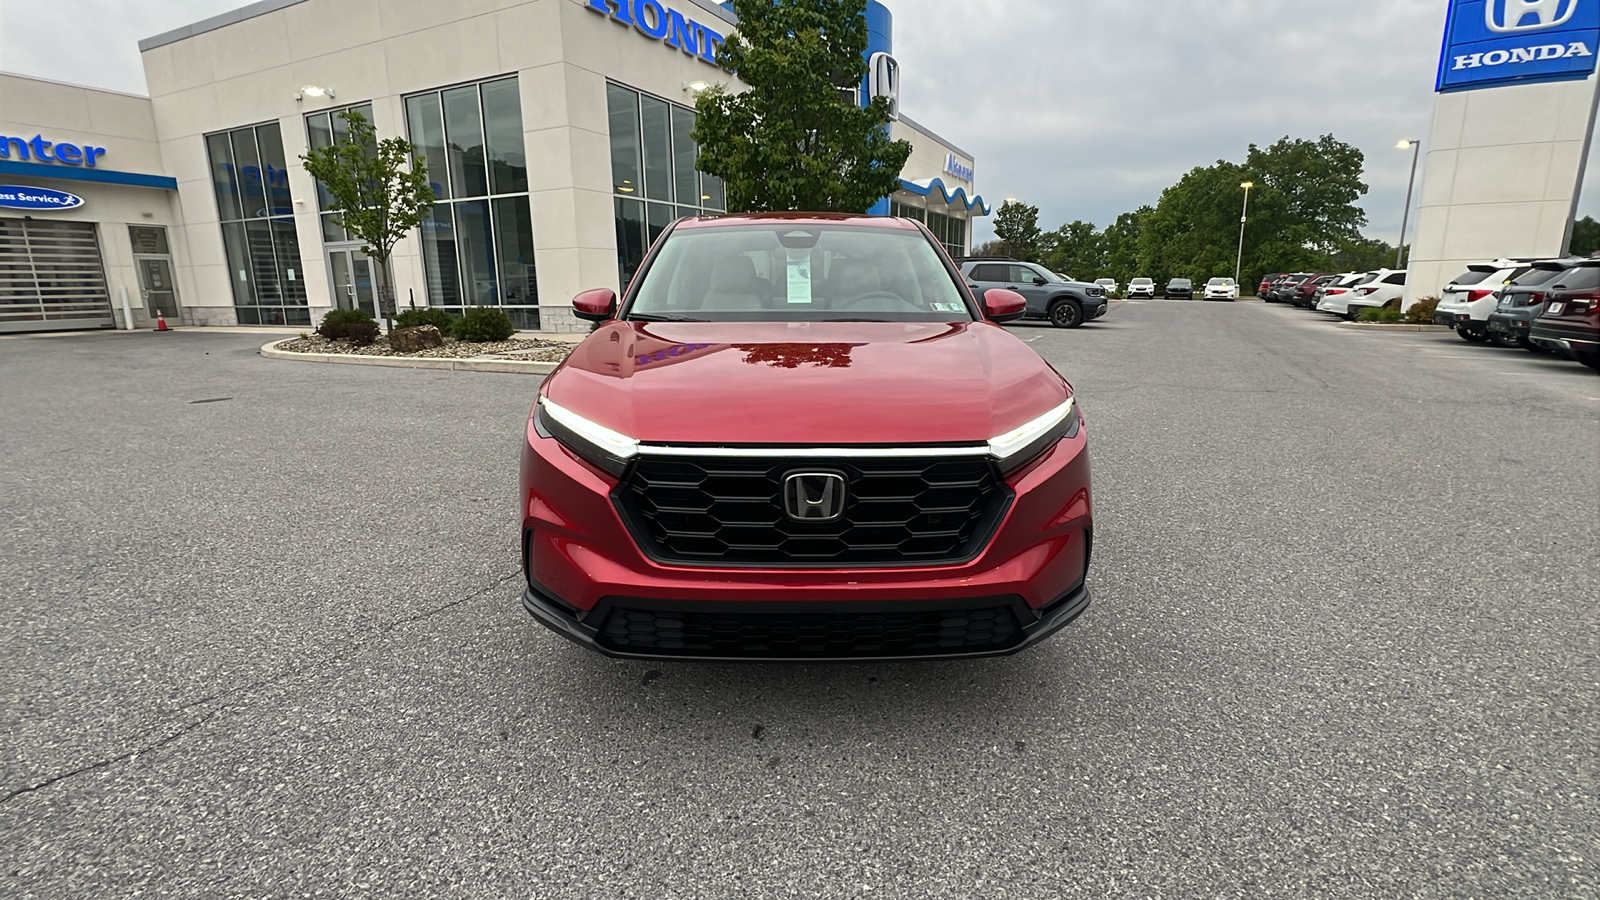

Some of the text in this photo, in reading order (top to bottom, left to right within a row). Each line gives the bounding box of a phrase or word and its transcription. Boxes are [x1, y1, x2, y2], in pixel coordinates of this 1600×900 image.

[1452, 42, 1592, 70] HONDA
[0, 134, 106, 166] nter
[17, 193, 60, 204] Service
